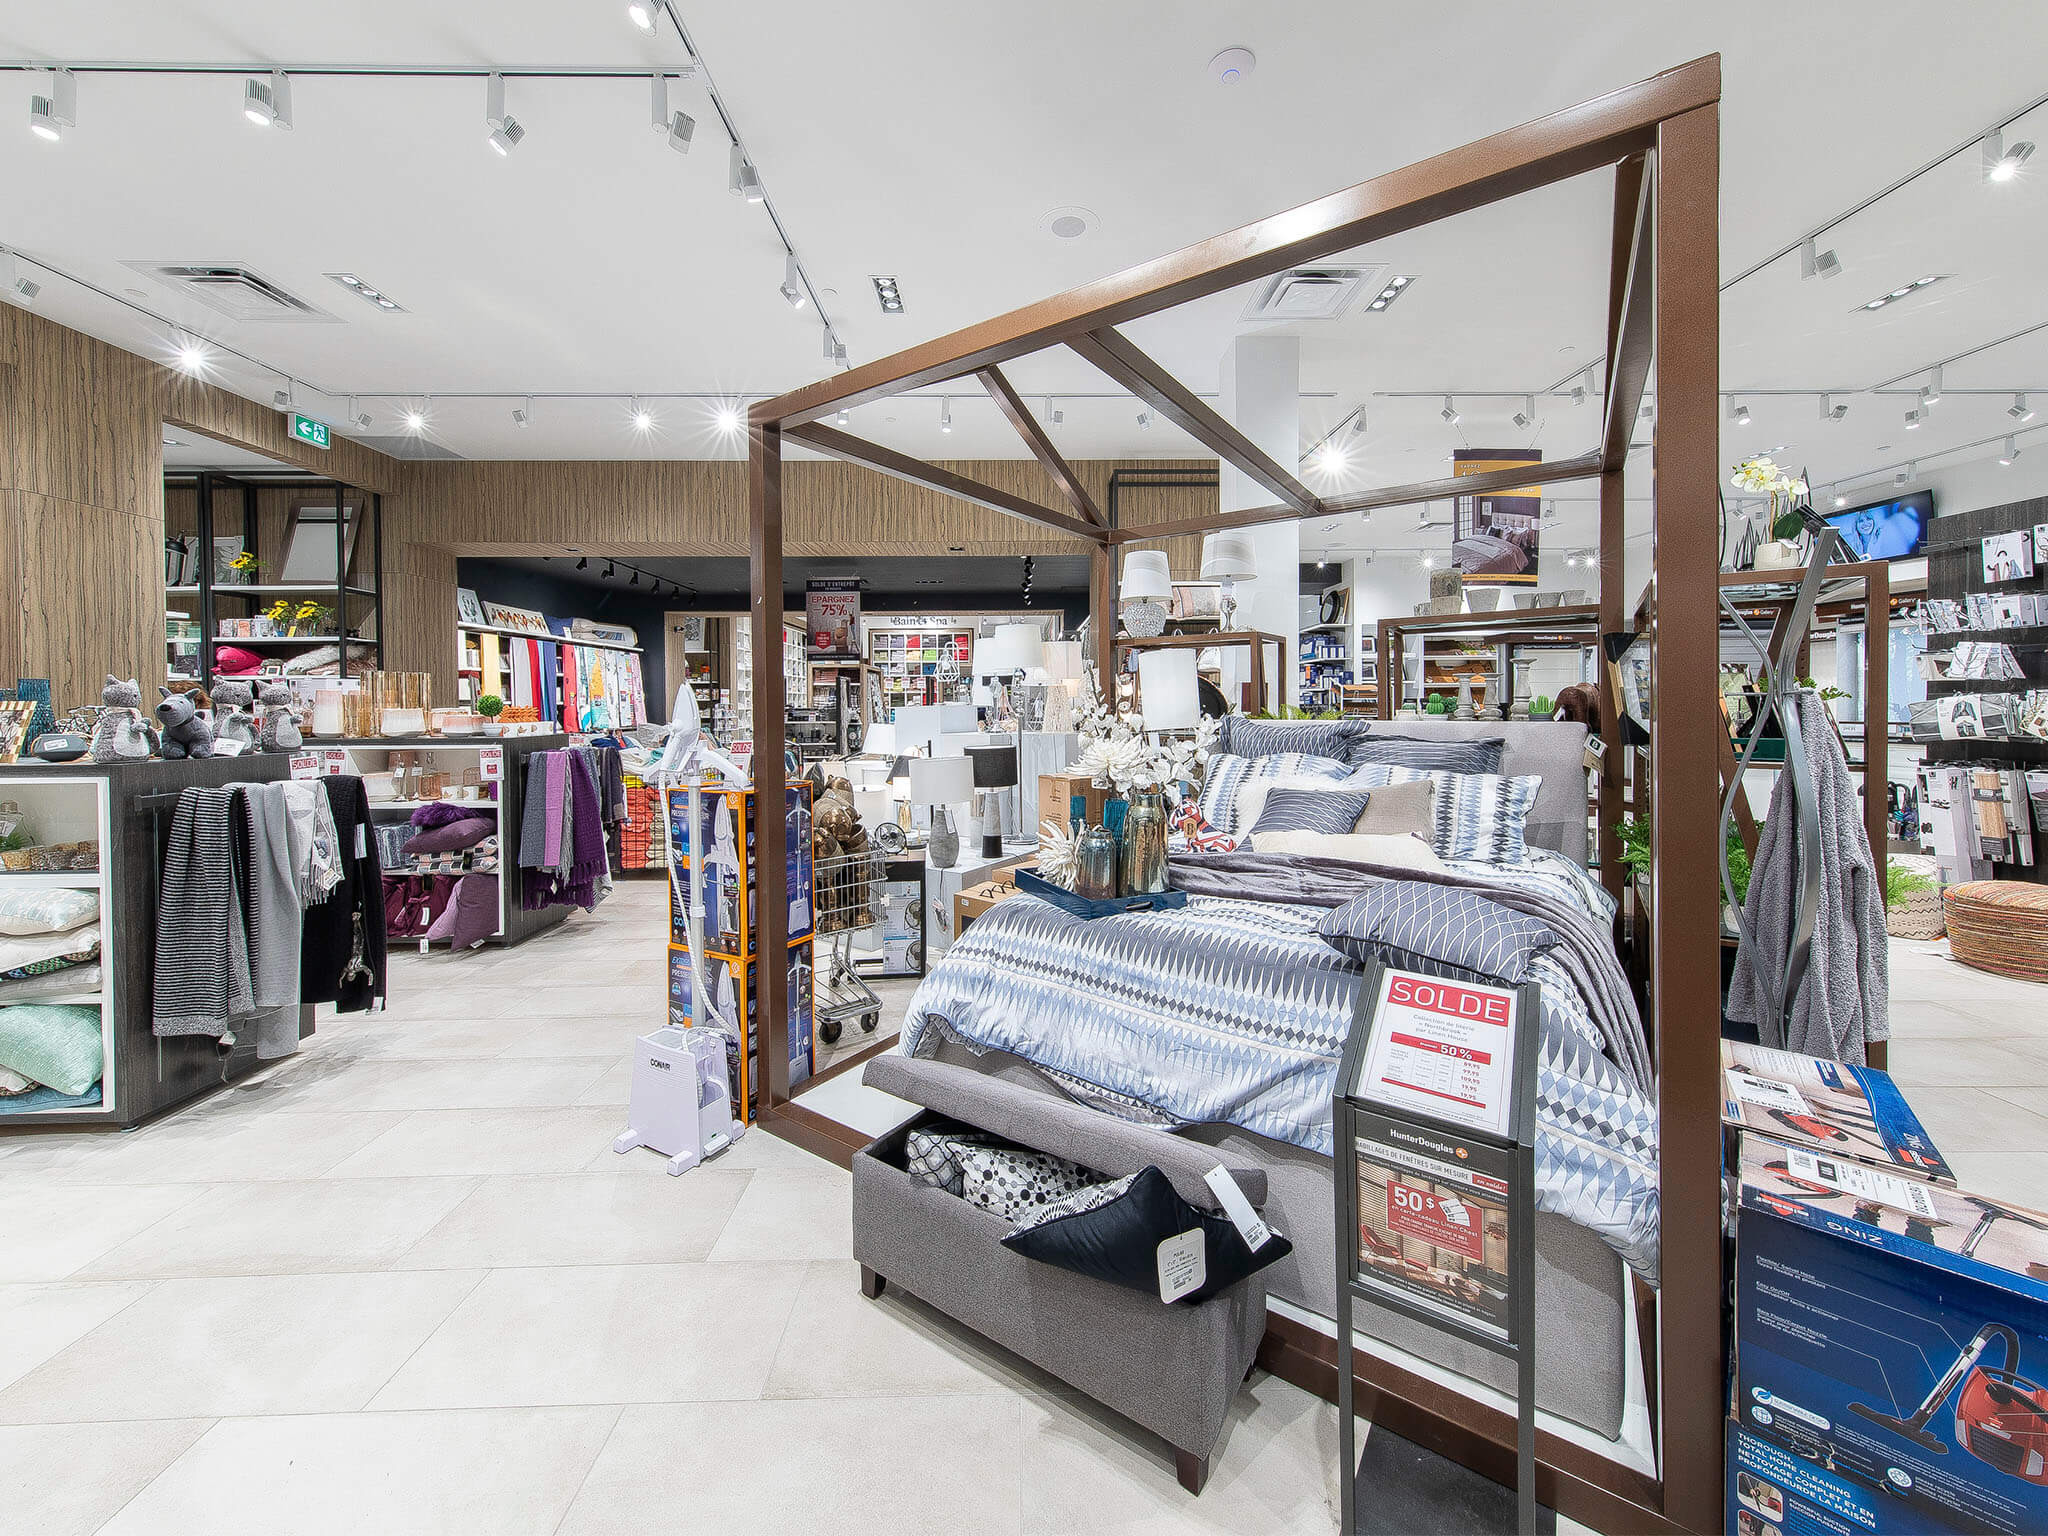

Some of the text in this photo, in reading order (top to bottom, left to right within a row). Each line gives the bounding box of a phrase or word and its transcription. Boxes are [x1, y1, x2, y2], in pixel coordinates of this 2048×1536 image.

[731, 742, 752, 753] SOLDE
[292, 759, 318, 769] SOLDE
[1391, 981, 1507, 1022] SOLDE
[1413, 1014, 1445, 1025] Collection
[1440, 1044, 1457, 1056] 50
[1459, 1048, 1473, 1060] %
[650, 1058, 671, 1072] CONAIR
[1390, 1129, 1454, 1154] HunterDouglas
[1390, 1150, 1399, 1159] DE
[1429, 1160, 1443, 1173] SUR
[1443, 1165, 1470, 1181] MESURE
[1393, 1186, 1435, 1212] 50 $
[1825, 1221, 1884, 1245] ZING
[1738, 1440, 1852, 1499] TOTAL HOME CLEANING
[1738, 1447, 1875, 1519] NETTOYAGE COMPLET ET EN
[1818, 1495, 1832, 1507] LA
[1834, 1503, 1876, 1529] MAISON
[1823, 1515, 1852, 1533] SUCTION
